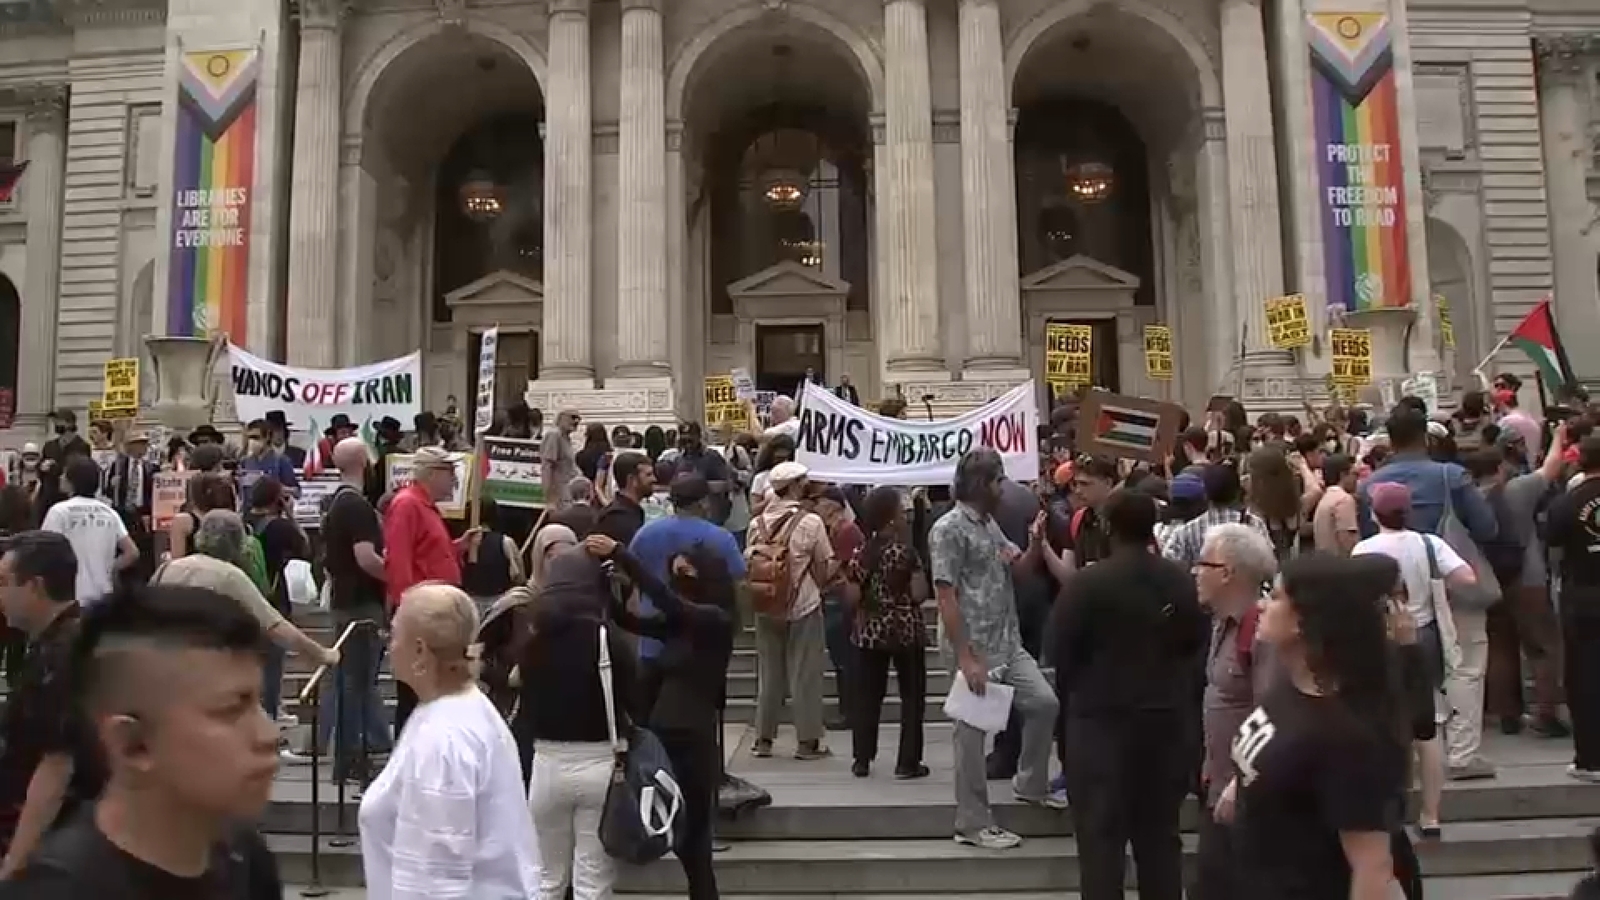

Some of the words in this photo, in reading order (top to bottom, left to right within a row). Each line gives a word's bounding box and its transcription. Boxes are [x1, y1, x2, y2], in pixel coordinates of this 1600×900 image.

[1347, 166, 1374, 183] TH
[183, 209, 209, 228] ARE
[1332, 208, 1352, 226] TO
[1048, 335, 1088, 353] NEEDS
[1332, 340, 1369, 357] NEEDS
[232, 365, 300, 403] HANDS
[301, 382, 349, 404] OFF
[352, 373, 413, 404] IRAN
[705, 386, 738, 404] NEED
[796, 408, 864, 460] ARMS
[870, 427, 972, 465] EMBARGO
[981, 411, 1027, 454] NOW
